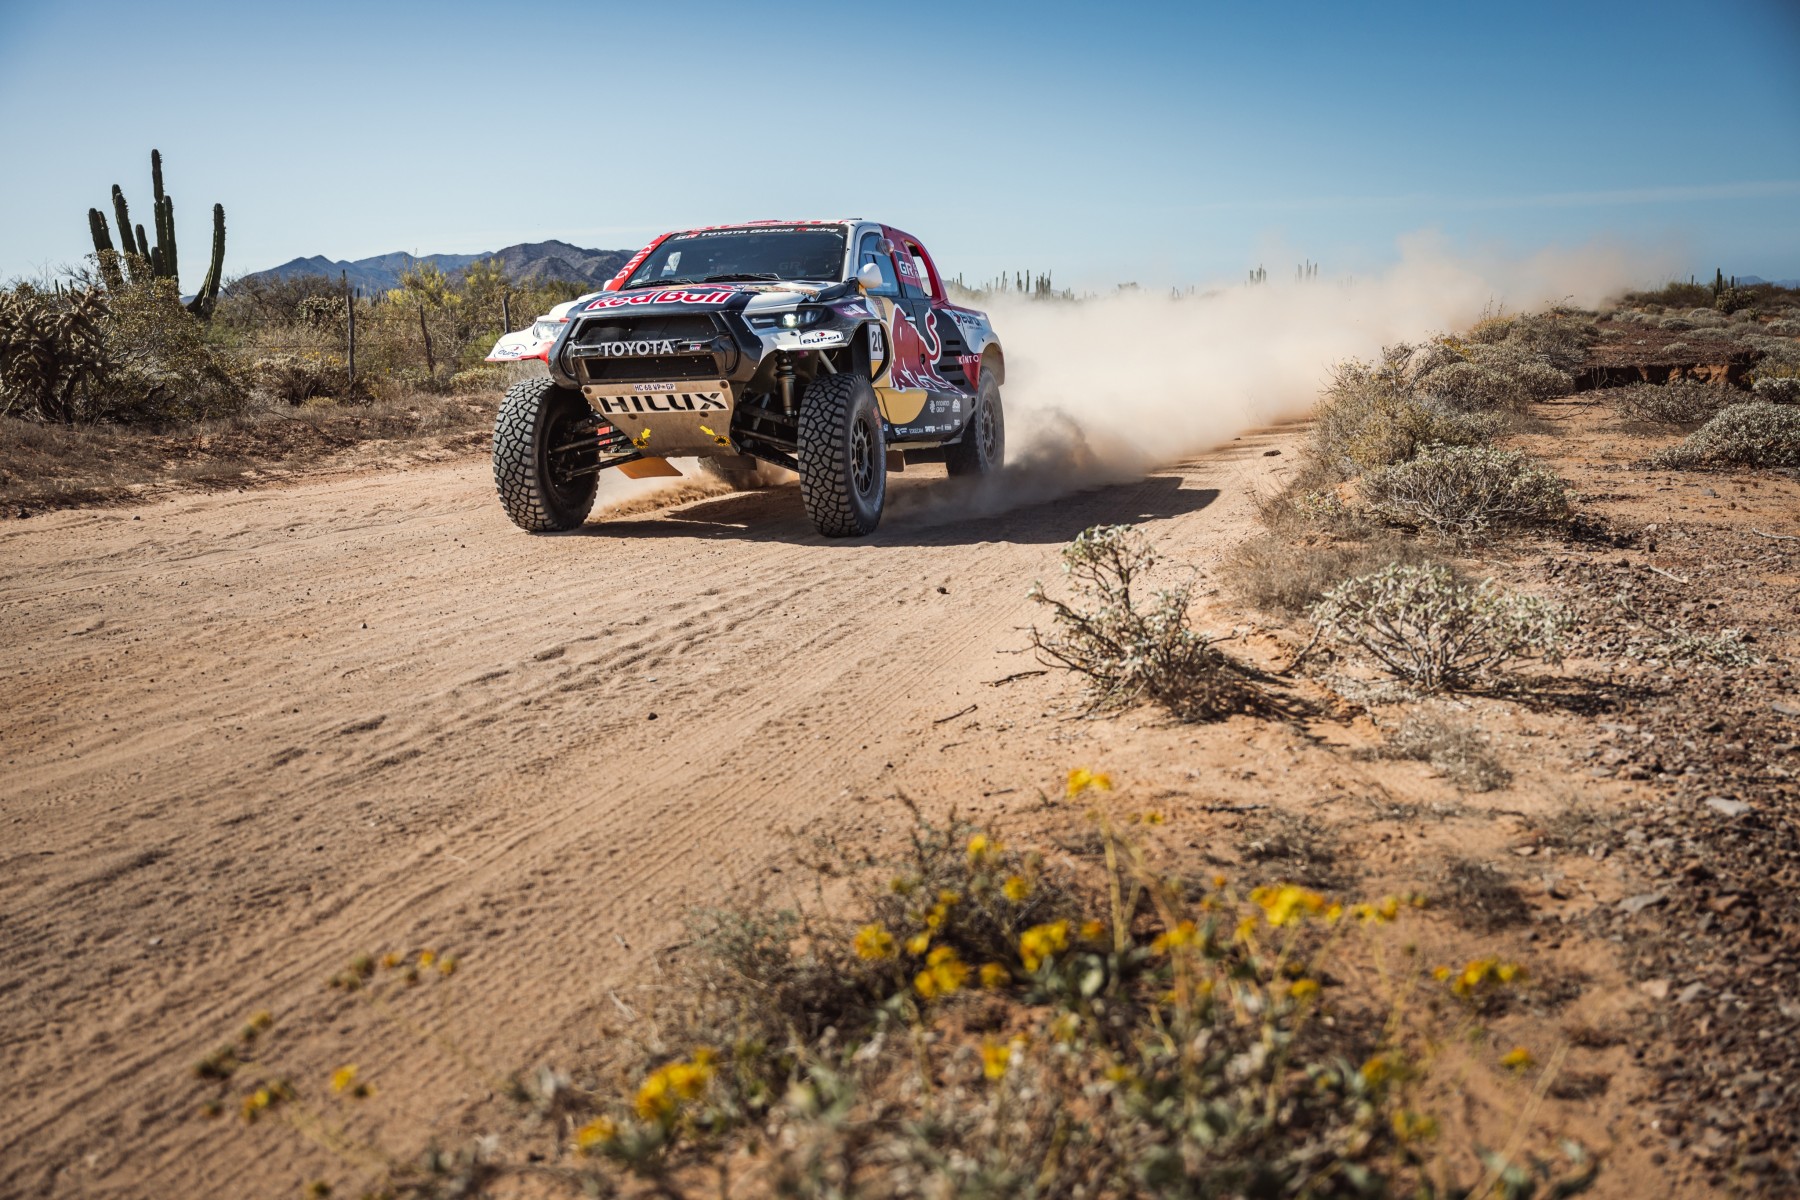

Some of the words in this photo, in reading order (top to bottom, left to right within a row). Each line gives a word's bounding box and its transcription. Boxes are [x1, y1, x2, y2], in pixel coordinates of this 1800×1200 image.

[701, 229, 748, 237] TOYOTA
[585, 291, 659, 311] Red
[654, 290, 736, 304] Bull
[600, 339, 674, 357] TOYOTA
[802, 334, 840, 344] eurol
[598, 392, 727, 412] HILUX
